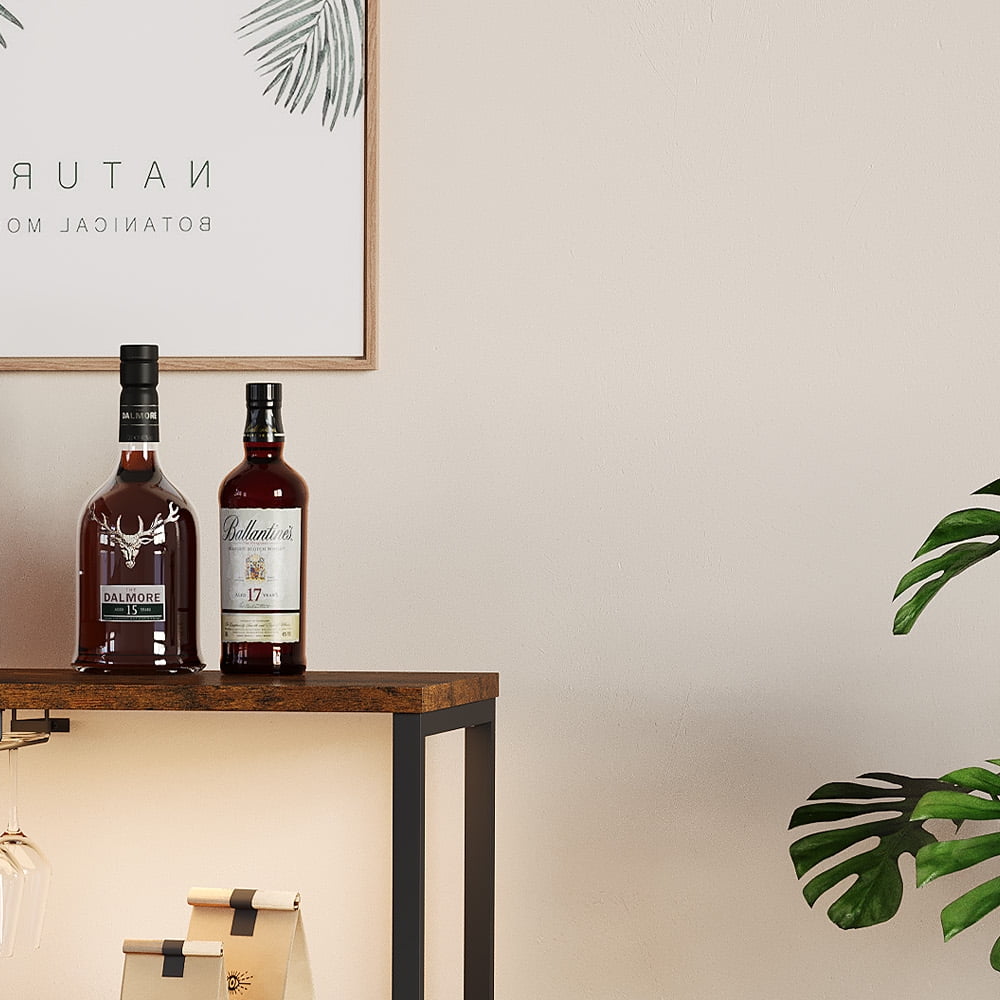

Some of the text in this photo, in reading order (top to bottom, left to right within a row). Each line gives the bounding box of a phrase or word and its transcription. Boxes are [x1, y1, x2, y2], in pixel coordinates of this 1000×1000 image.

[122, 411, 157, 420] DALMORE
[103, 592, 161, 603] DALMORE
[247, 588, 262, 602] 17
[126, 604, 138, 615] 15
